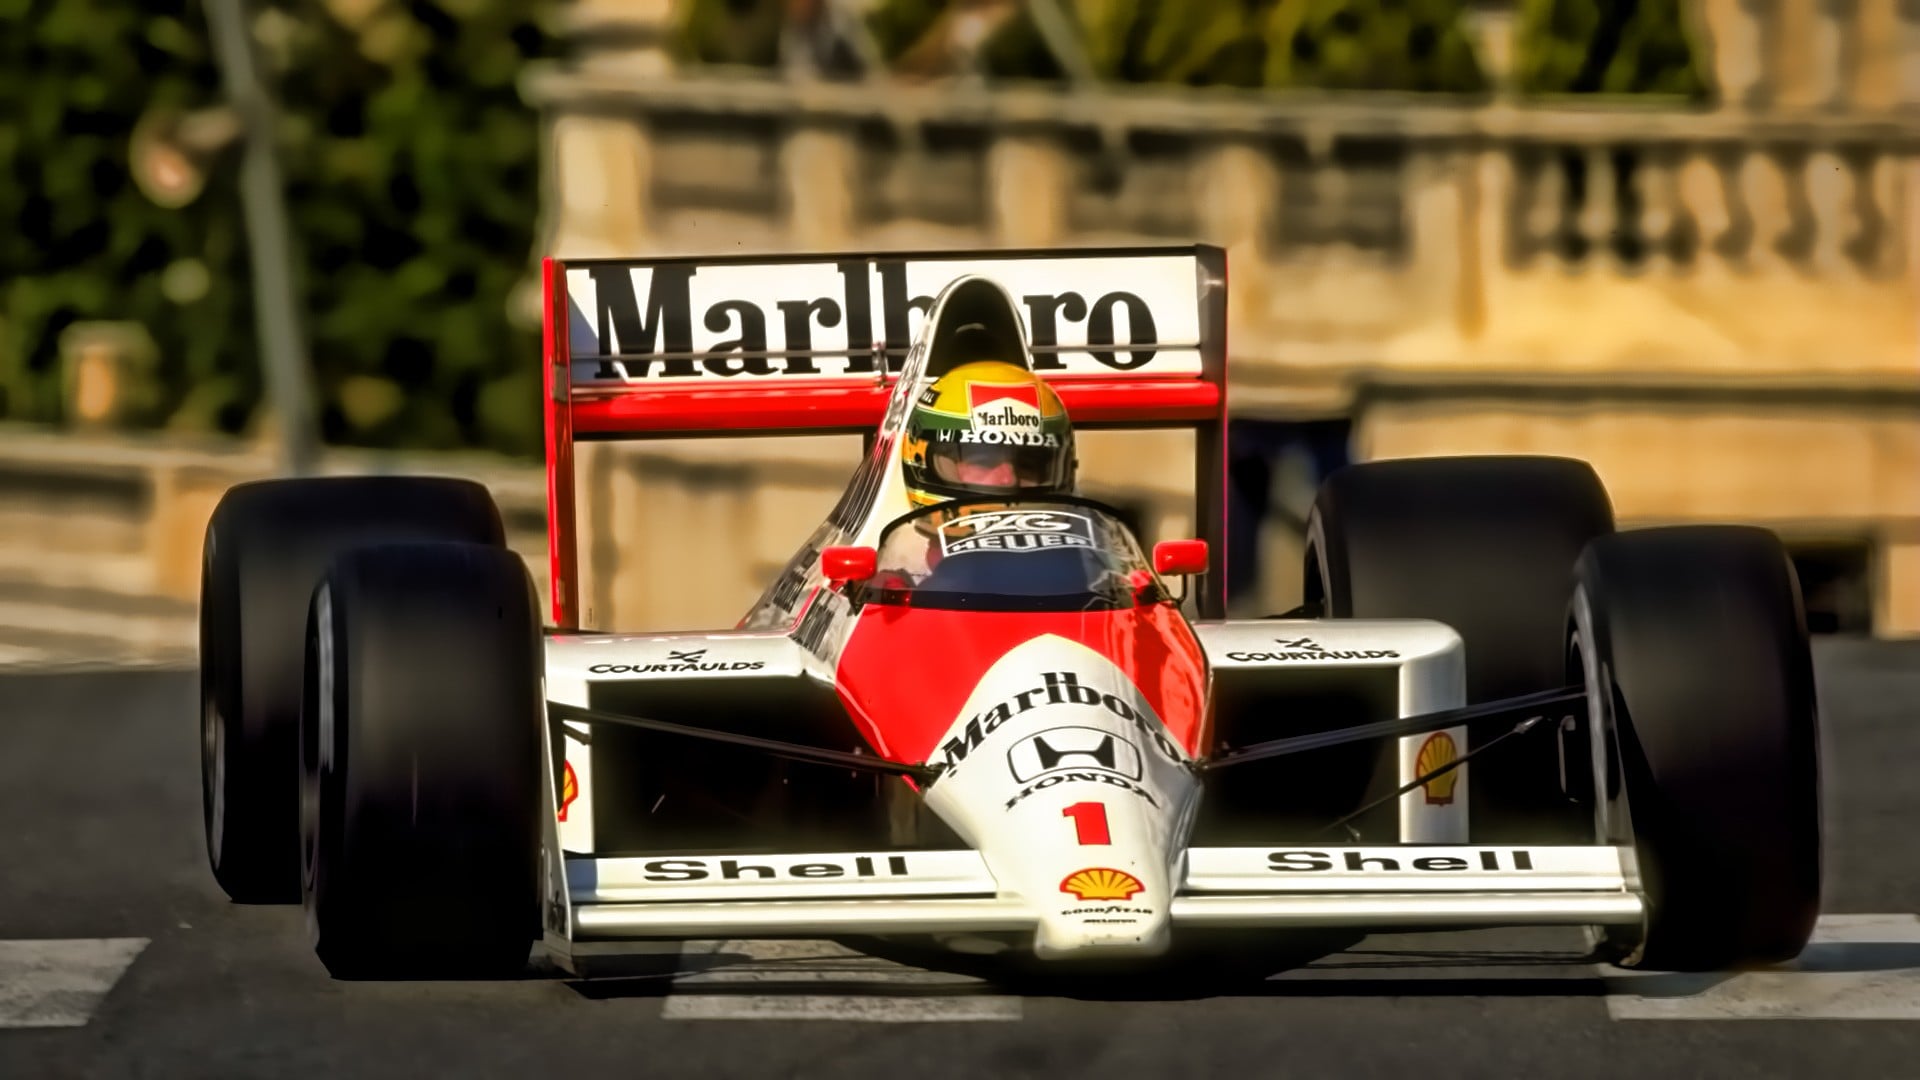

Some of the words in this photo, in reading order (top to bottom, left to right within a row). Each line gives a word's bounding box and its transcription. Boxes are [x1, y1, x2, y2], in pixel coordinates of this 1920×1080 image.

[589, 261, 1157, 378] Marlbro
[959, 429, 1060, 448] HONDA
[958, 513, 1072, 535] TAG
[952, 534, 1087, 552] HEUER
[1226, 650, 1401, 662] COURTAULDS
[588, 661, 765, 674] COURTAULDS
[940, 672, 1181, 778] Marlboro
[1005, 772, 1160, 812] HONDA
[1062, 801, 1112, 845] 1
[643, 856, 908, 881] Shell
[1267, 850, 1533, 872] Shell
